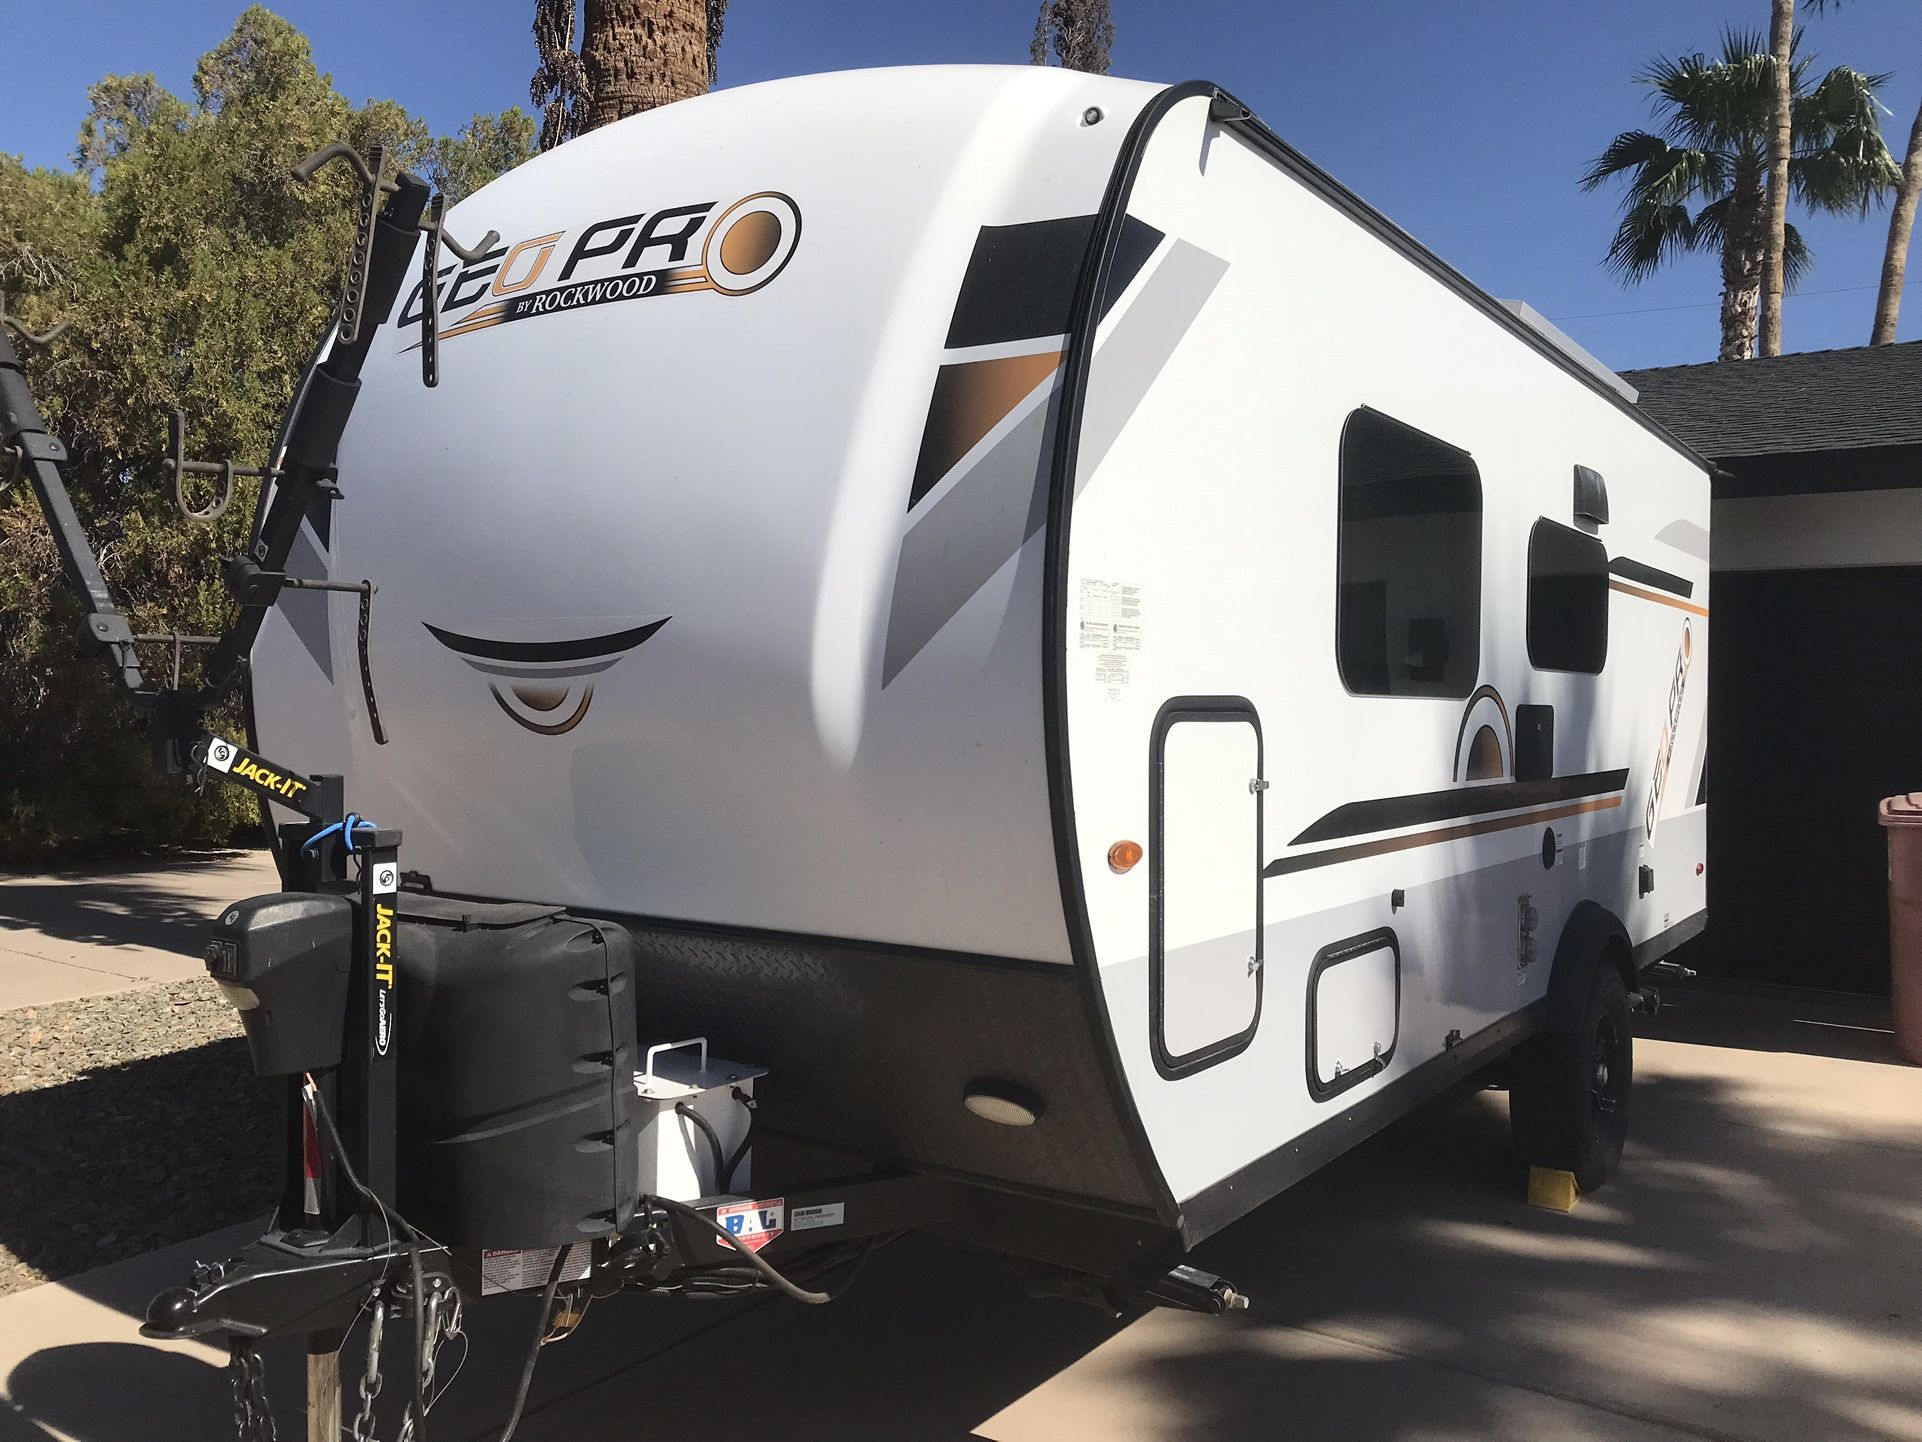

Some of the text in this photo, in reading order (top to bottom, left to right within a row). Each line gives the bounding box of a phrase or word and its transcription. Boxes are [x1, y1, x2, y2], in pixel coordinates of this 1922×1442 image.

[397, 190, 802, 329] GEO PRO
[516, 274, 657, 314] BY ROCKWOOD
[232, 757, 306, 799] JACK-IT
[375, 903, 394, 989] JACK-IT
